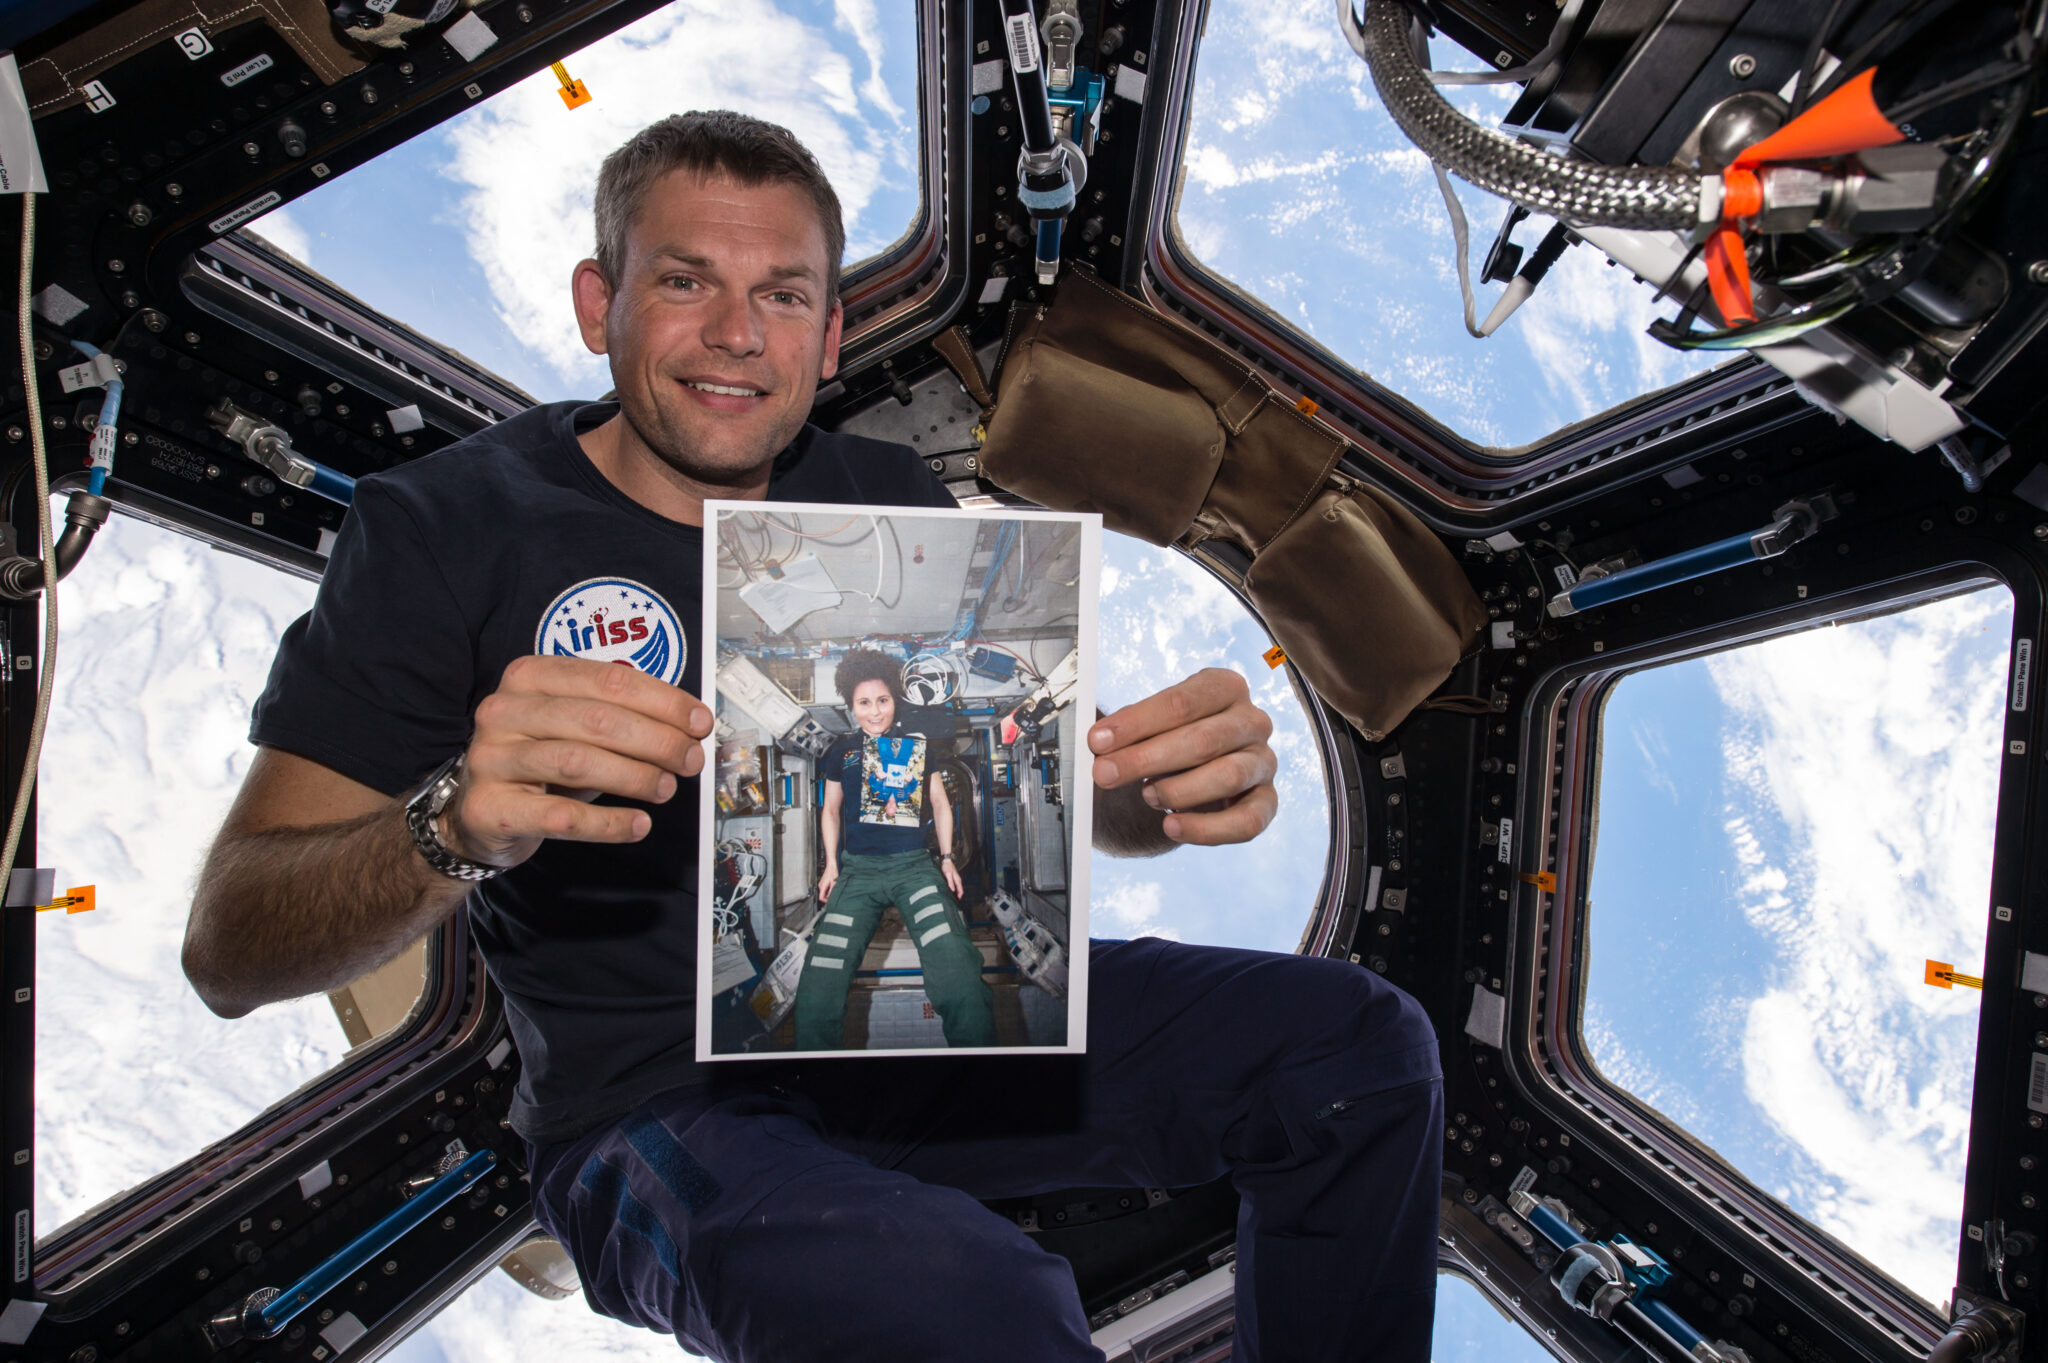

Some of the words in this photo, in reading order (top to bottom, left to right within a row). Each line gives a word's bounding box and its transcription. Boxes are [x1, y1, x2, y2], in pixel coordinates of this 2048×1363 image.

[180, 32, 207, 56] G
[248, 193, 276, 212] Scratch
[219, 216, 234, 227] Win
[232, 207, 250, 220] Pane
[567, 613, 649, 652] iriss
[2019, 647, 2027, 661] Win
[2017, 662, 2026, 679] Pane
[2015, 680, 2025, 707] Scratch
[17, 1213, 27, 1239] Scratch
[17, 1240, 26, 1257] Pane
[17, 1258, 26, 1271] Win
